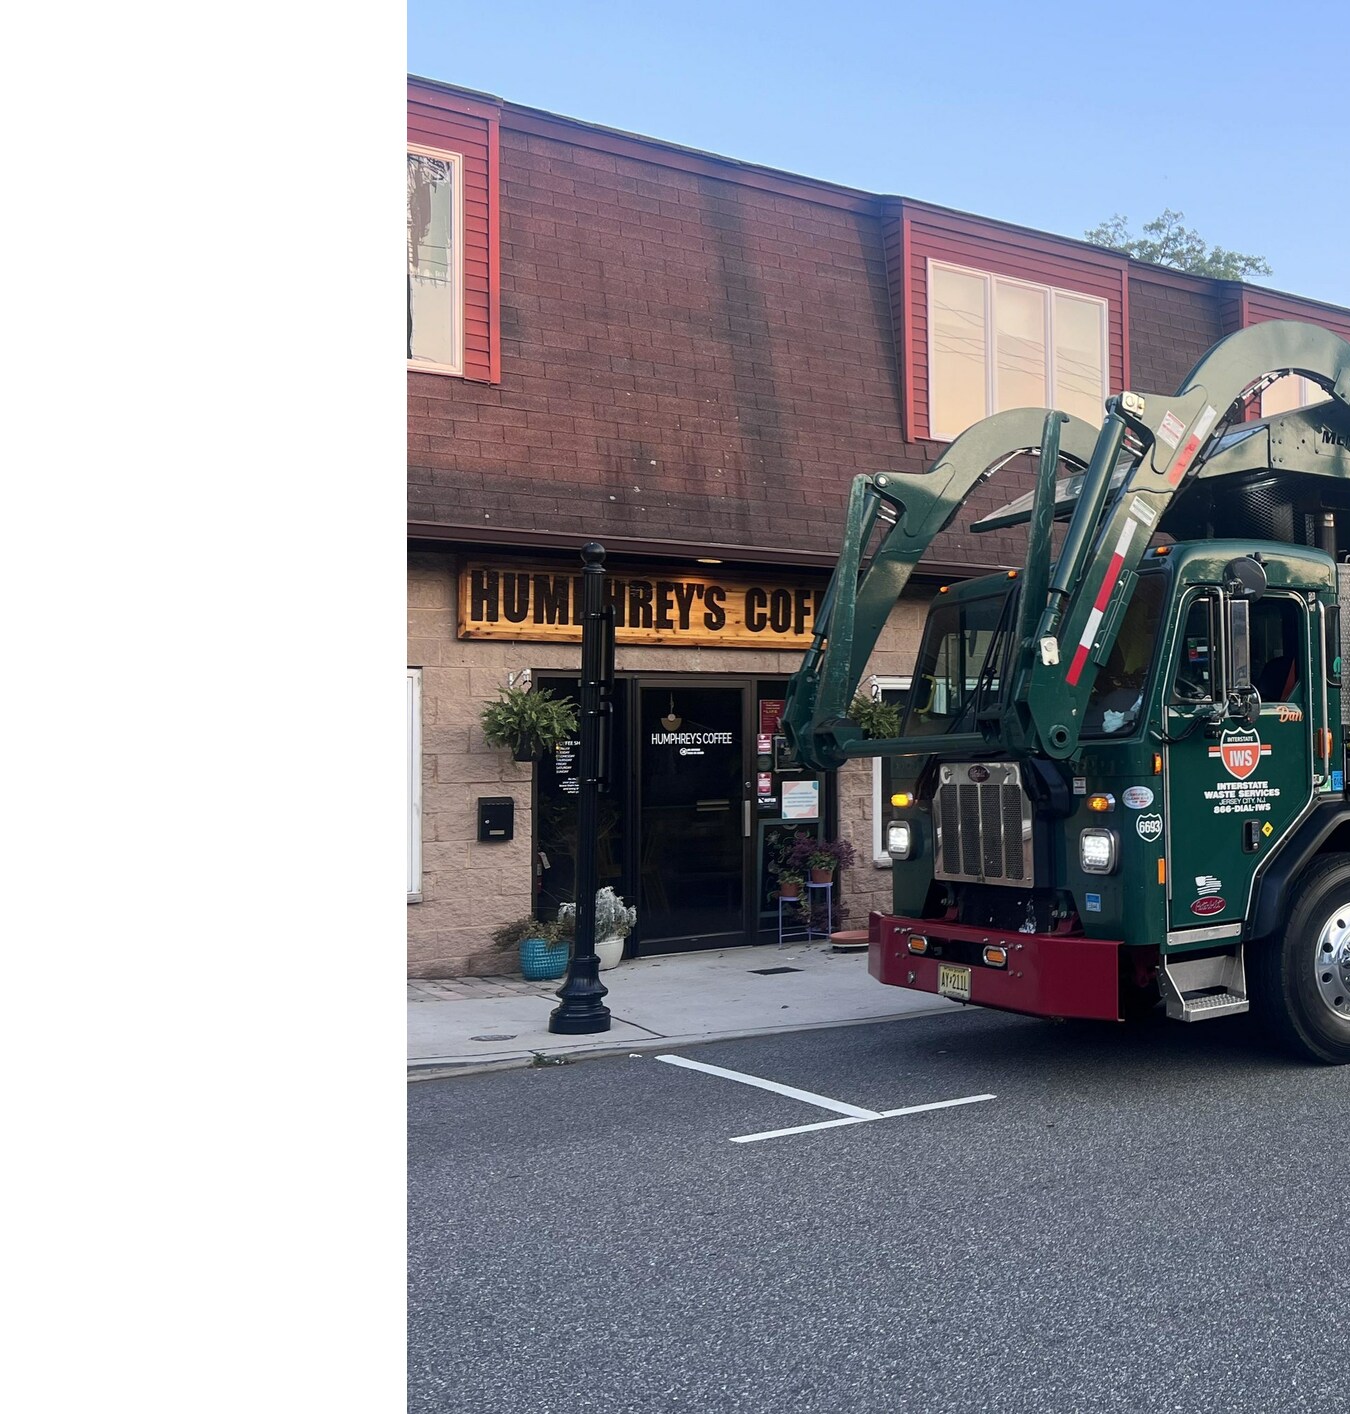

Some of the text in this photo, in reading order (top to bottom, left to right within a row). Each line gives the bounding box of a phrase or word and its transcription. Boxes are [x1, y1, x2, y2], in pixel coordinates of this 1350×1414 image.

[1276, 706, 1303, 722] Dan
[702, 732, 732, 744] COFFEE
[1229, 750, 1253, 767] IWS
[1217, 781, 1268, 790] INTERSTATE
[1204, 789, 1280, 799] WASTE SERVICES
[1214, 803, 1271, 814] 866-DIAL-IWS
[1139, 820, 1160, 833] 6693
